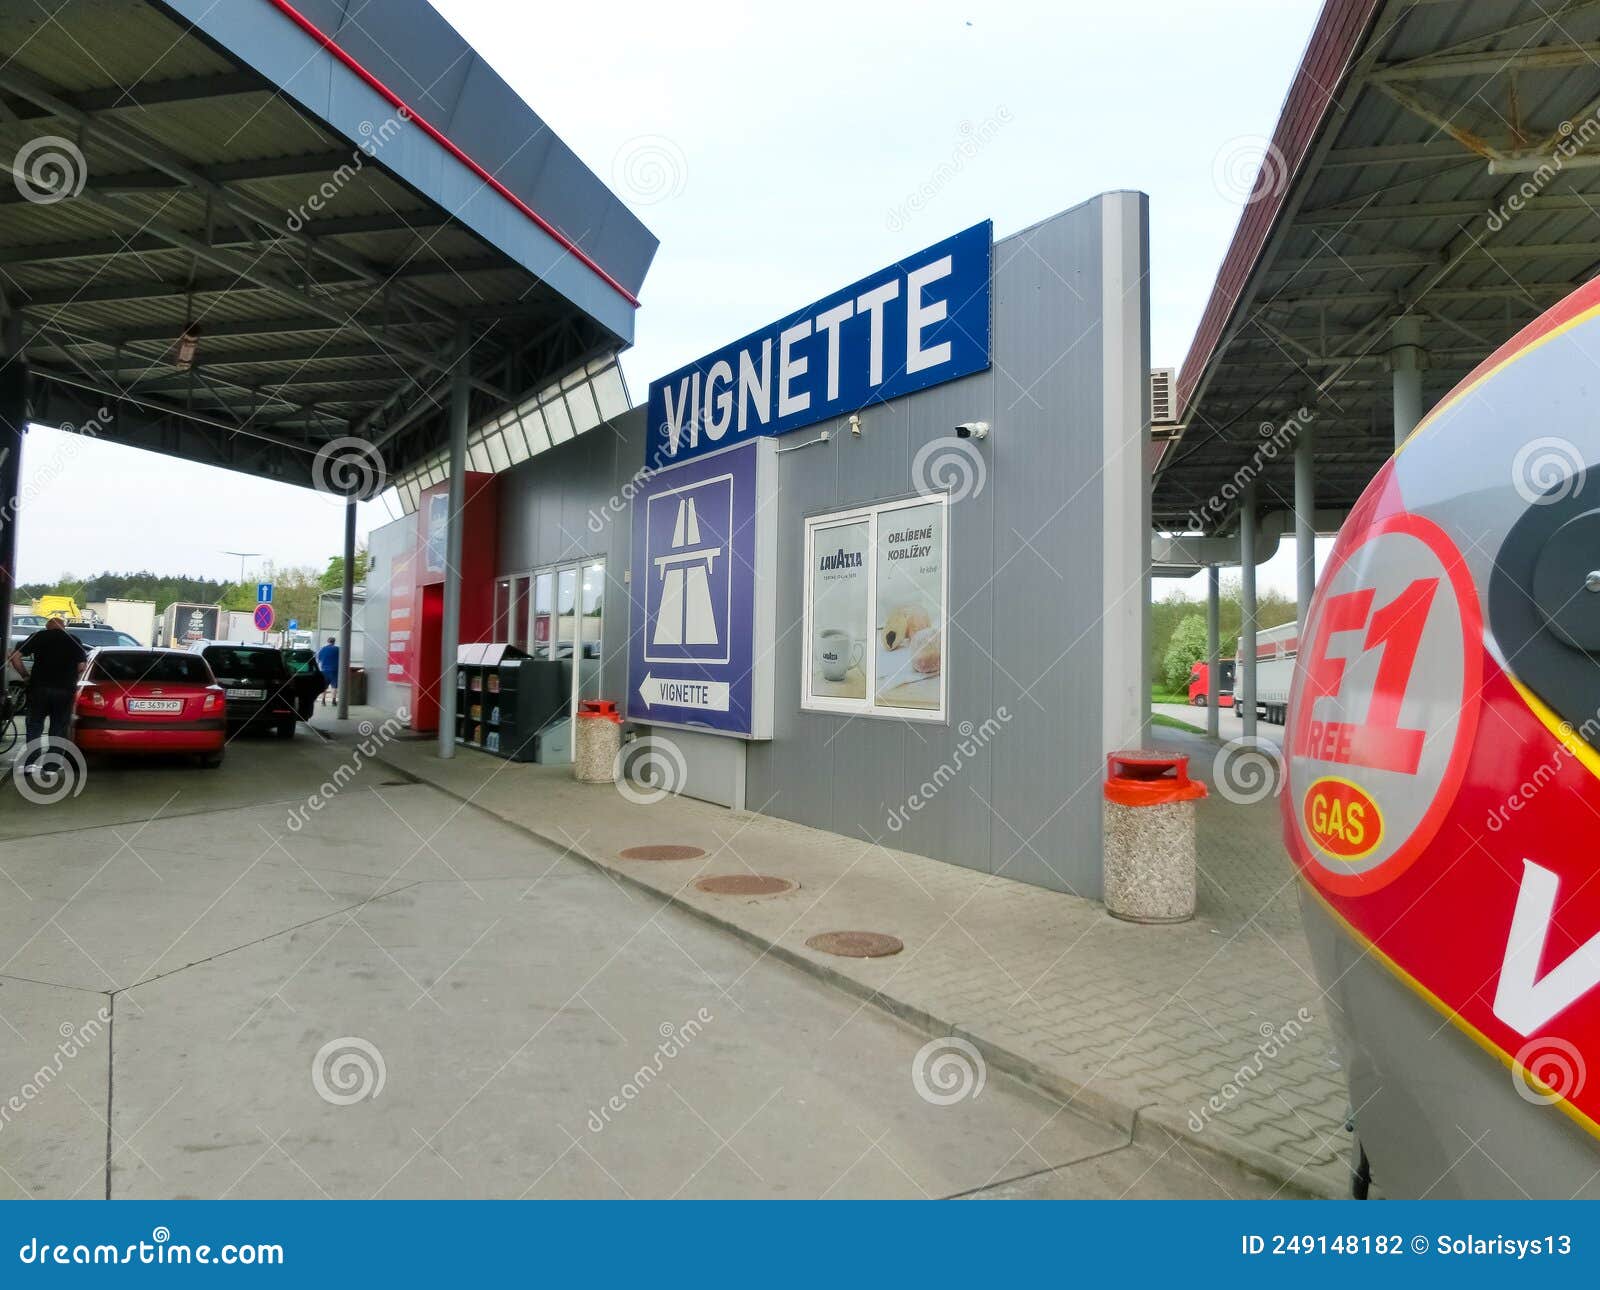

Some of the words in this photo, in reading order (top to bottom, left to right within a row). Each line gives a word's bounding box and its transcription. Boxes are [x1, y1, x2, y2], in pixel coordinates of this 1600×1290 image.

[664, 254, 952, 455] VIGNETTE
[888, 524, 933, 544] OBLÍBENÉ
[820, 548, 863, 571] LAVAZZA
[887, 544, 931, 561] KOBLÍŽKY
[660, 683, 709, 705] VIGNETTE
[1311, 793, 1365, 845] GAS
